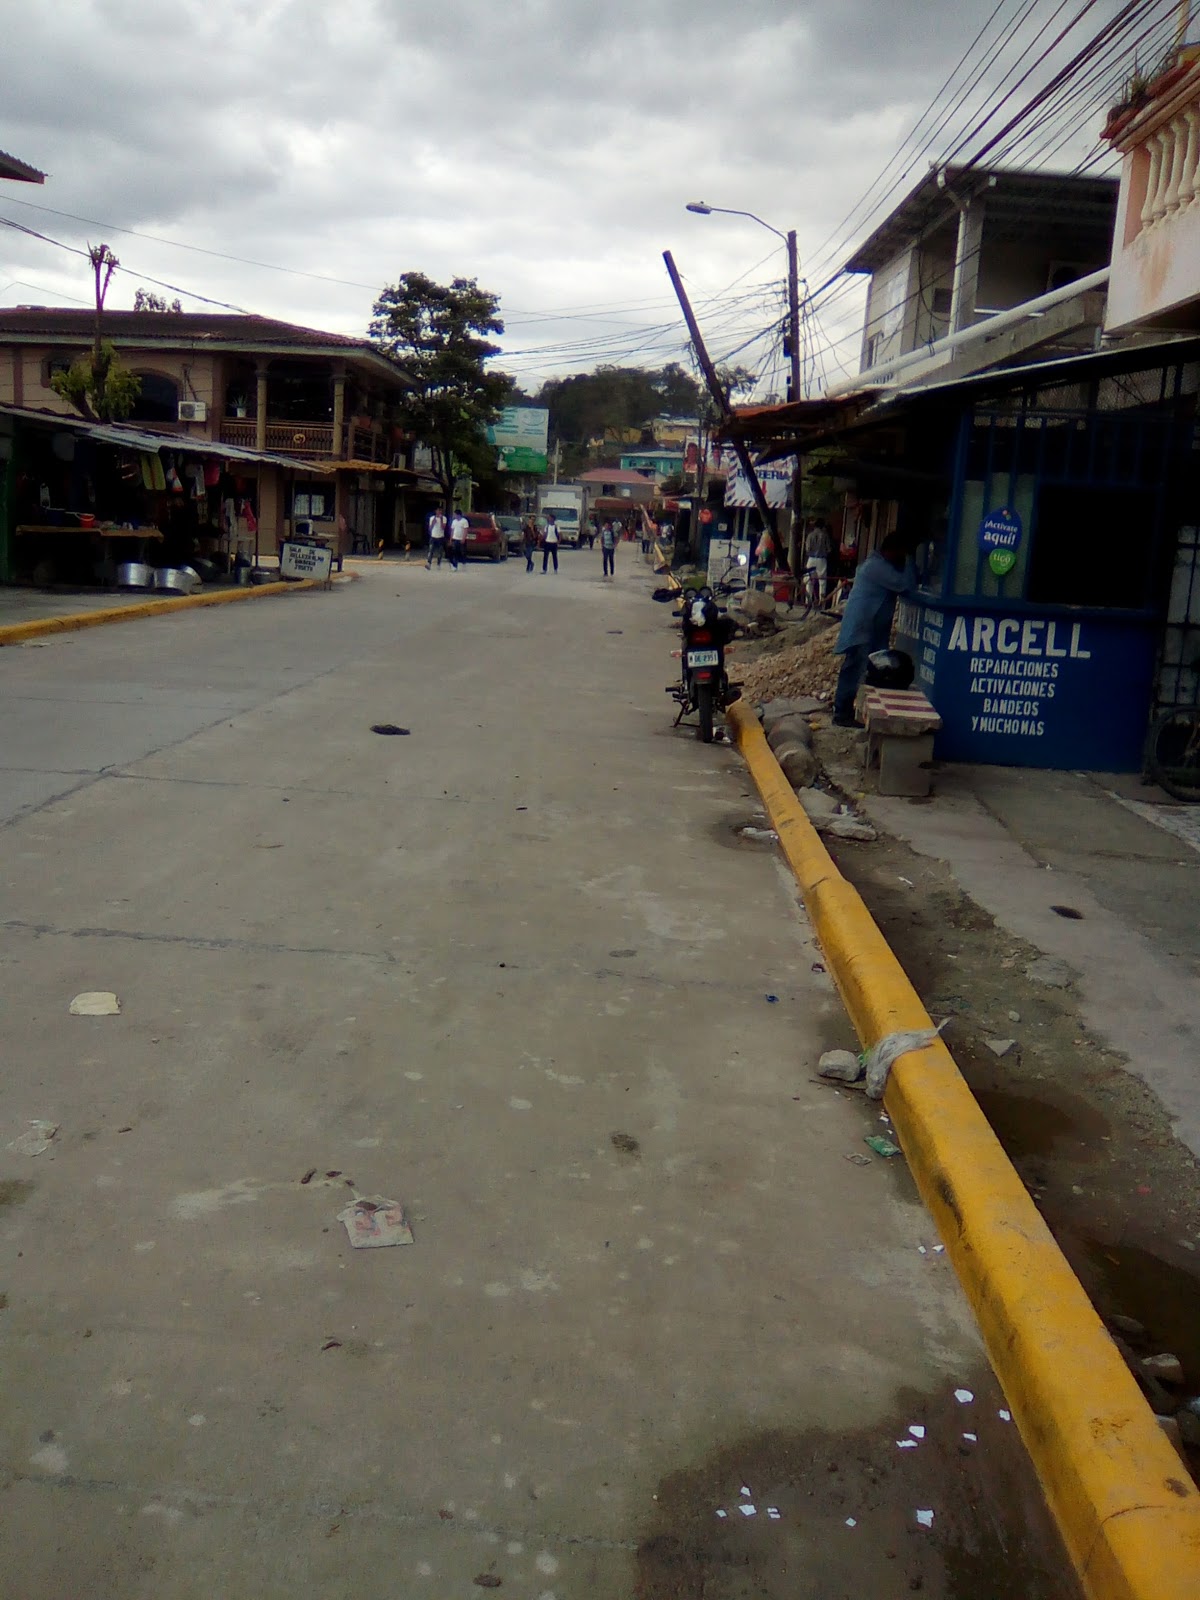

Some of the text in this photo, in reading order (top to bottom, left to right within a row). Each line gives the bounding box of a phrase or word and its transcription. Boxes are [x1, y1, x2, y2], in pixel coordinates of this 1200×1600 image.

[947, 616, 1091, 658] ARCELL
[970, 657, 1059, 678] REPARACIONES
[970, 677, 1056, 698] ACTIVACIONES
[983, 698, 1039, 717] BANDEOS
